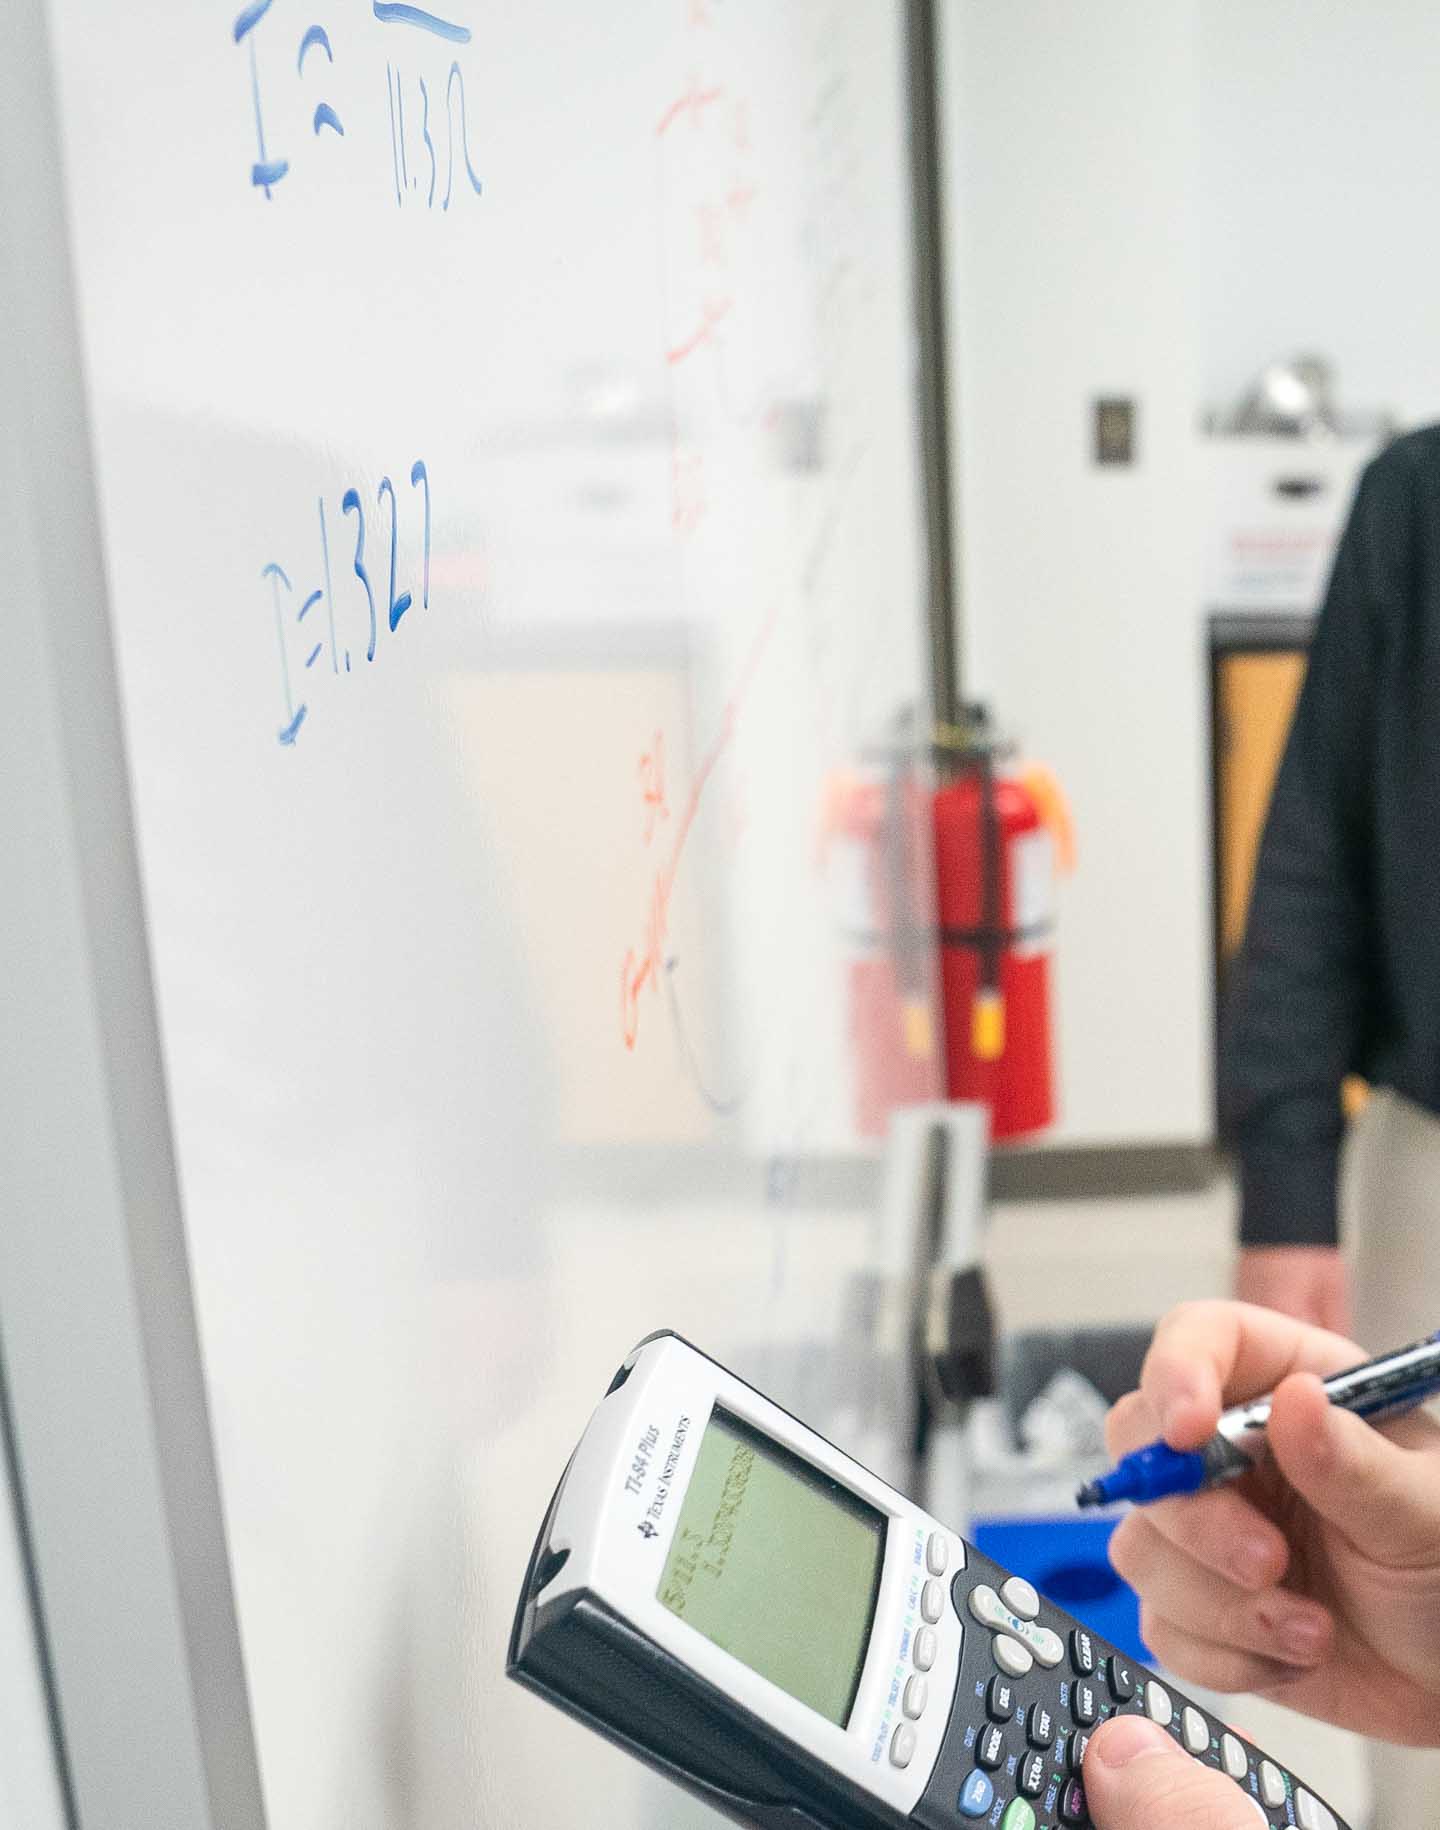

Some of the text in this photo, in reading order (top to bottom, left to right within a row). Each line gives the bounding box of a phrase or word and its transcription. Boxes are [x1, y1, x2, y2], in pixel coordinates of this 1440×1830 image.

[624, 1424, 660, 1495] TI-84 Plus
[646, 1415, 690, 1520] TEXAS INSTRUMENTS
[1080, 1633, 1093, 1670] CLEAR
[999, 1687, 1011, 1709] DEL
[1083, 1687, 1094, 1717] VARS
[1040, 1709, 1051, 1738] STAT
[986, 1728, 1003, 1762] MODE
